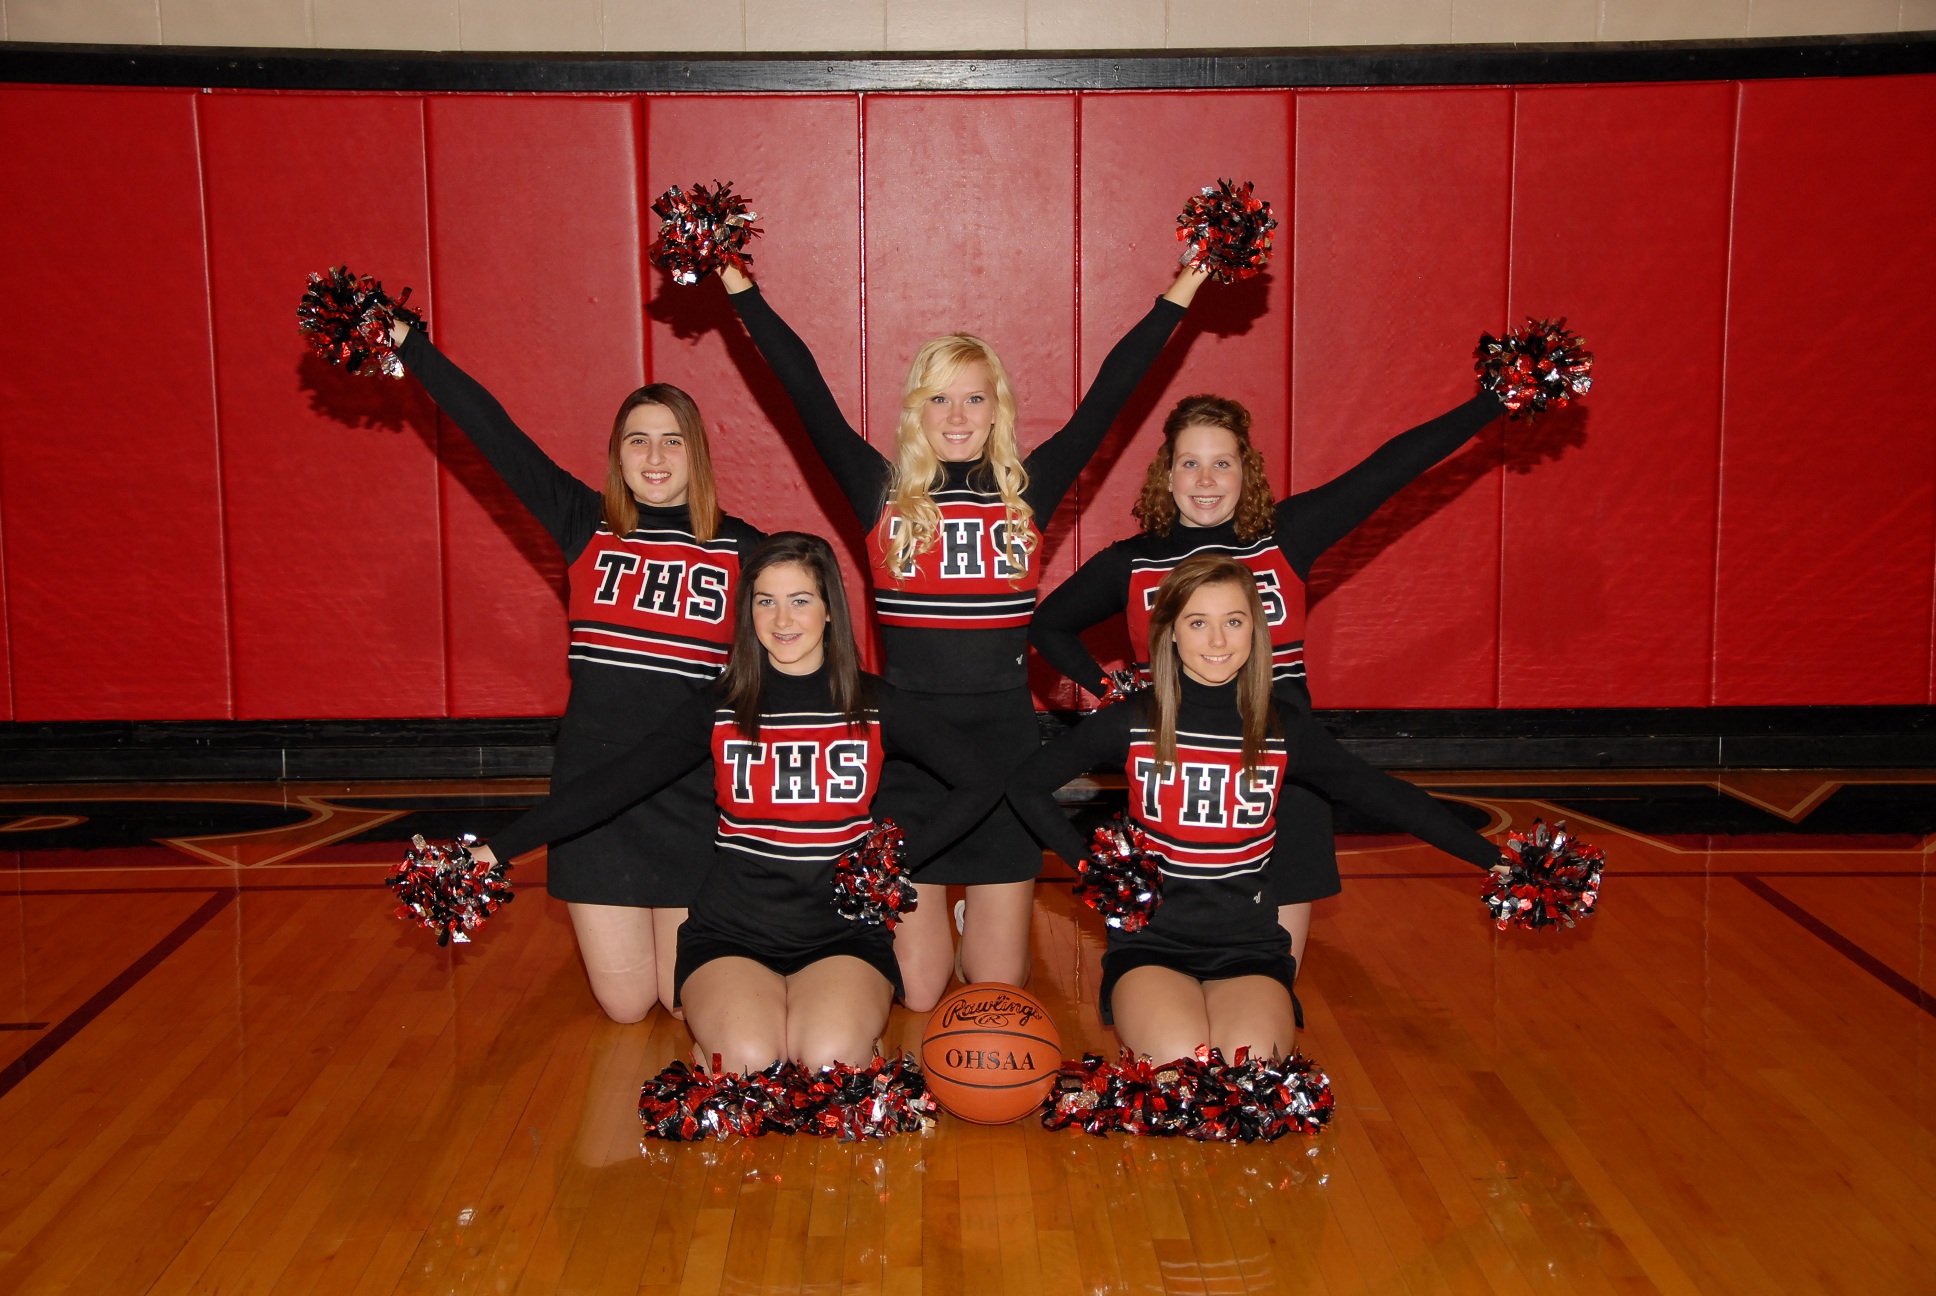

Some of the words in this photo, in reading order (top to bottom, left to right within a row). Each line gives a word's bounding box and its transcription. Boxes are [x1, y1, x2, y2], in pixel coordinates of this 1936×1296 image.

[594, 550, 728, 624] THS
[724, 740, 868, 803] THS
[1135, 757, 1279, 828] THS
[942, 995, 1042, 1028] Rawlings
[945, 1049, 1035, 1070] OHSAA
